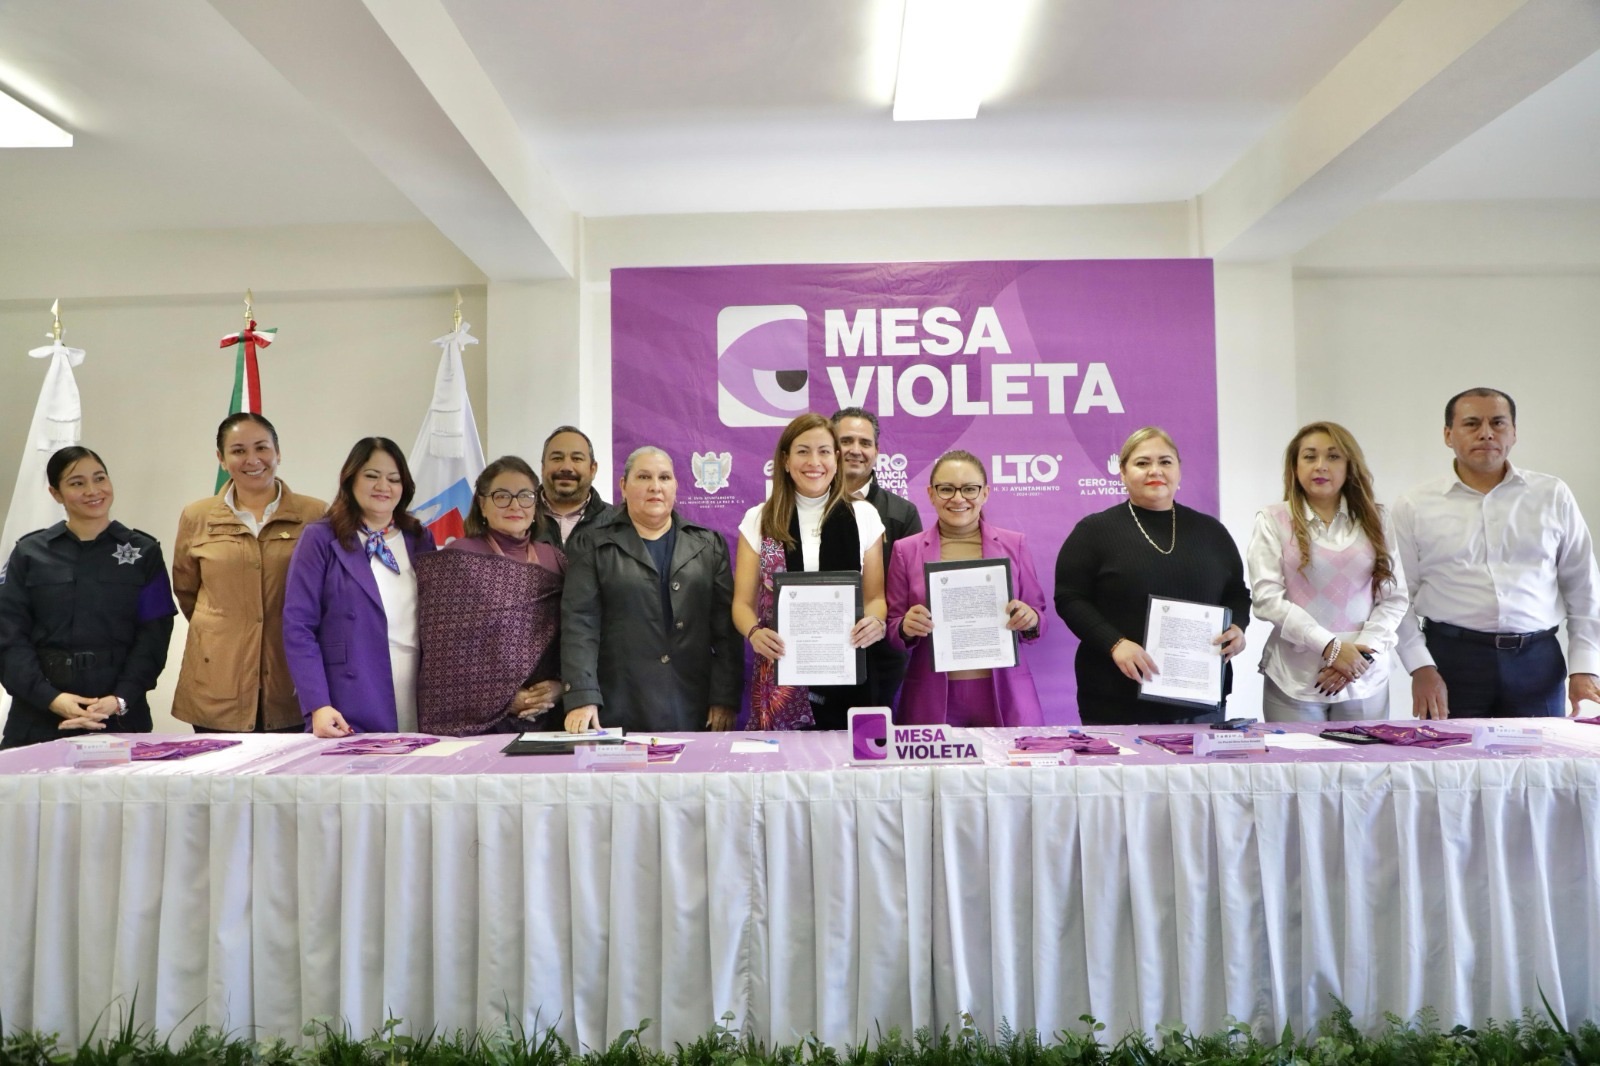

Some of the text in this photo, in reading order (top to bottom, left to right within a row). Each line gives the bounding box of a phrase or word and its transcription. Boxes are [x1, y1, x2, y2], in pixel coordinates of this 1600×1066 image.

[824, 306, 1012, 357] MESA
[826, 362, 1125, 417] VIOLETA
[873, 453, 908, 471] RO
[877, 480, 908, 488] ENCIA
[1078, 478, 1107, 487] CERO
[894, 728, 946, 743] MESA
[896, 743, 978, 760] VIOLETA
